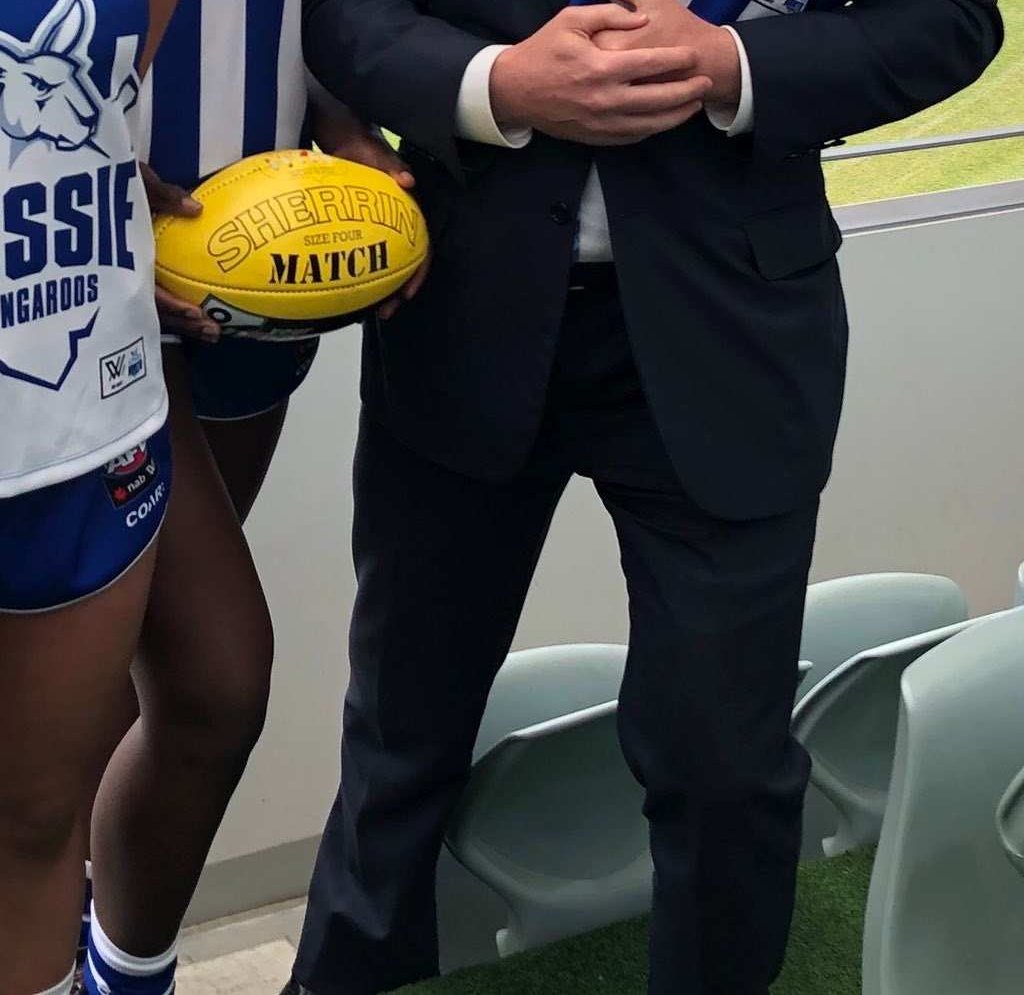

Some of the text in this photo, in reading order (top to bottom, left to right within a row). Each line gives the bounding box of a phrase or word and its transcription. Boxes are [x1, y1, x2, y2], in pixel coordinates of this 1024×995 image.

[207, 185, 418, 273] SHERRIN
[304, 229, 363, 246] SIZE FOUR
[269, 240, 389, 285] MATCH
[127, 474, 146, 493] nab
